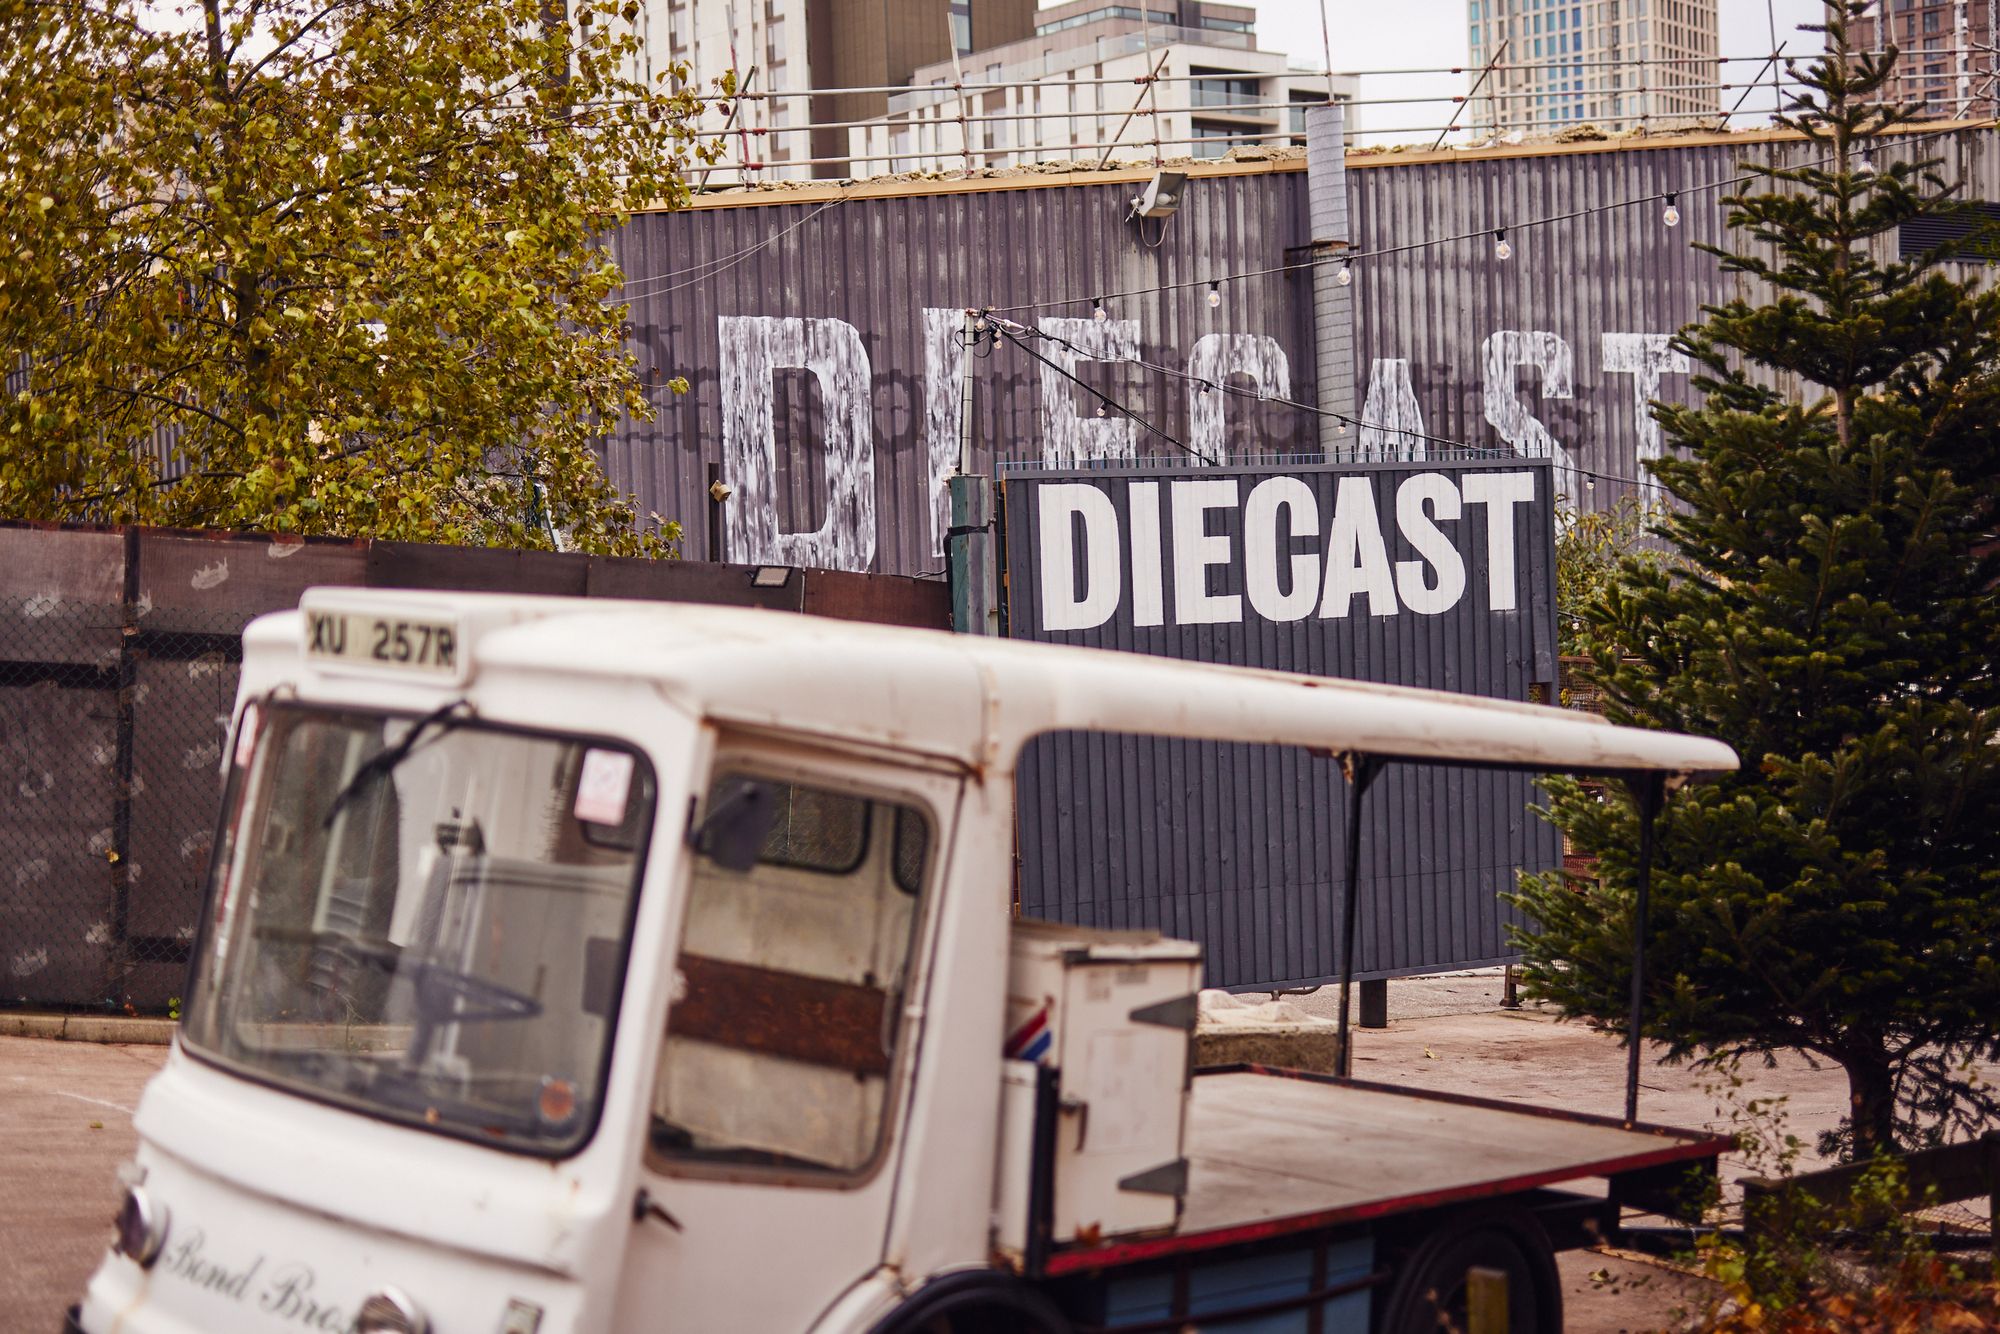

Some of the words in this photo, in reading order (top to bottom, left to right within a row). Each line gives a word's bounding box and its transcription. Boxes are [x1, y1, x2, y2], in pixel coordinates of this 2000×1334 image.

[1038, 471, 1535, 632] DIECAST
[307, 612, 347, 654] XU
[372, 620, 454, 666] 257R
[166, 1226, 266, 1302] Bond
